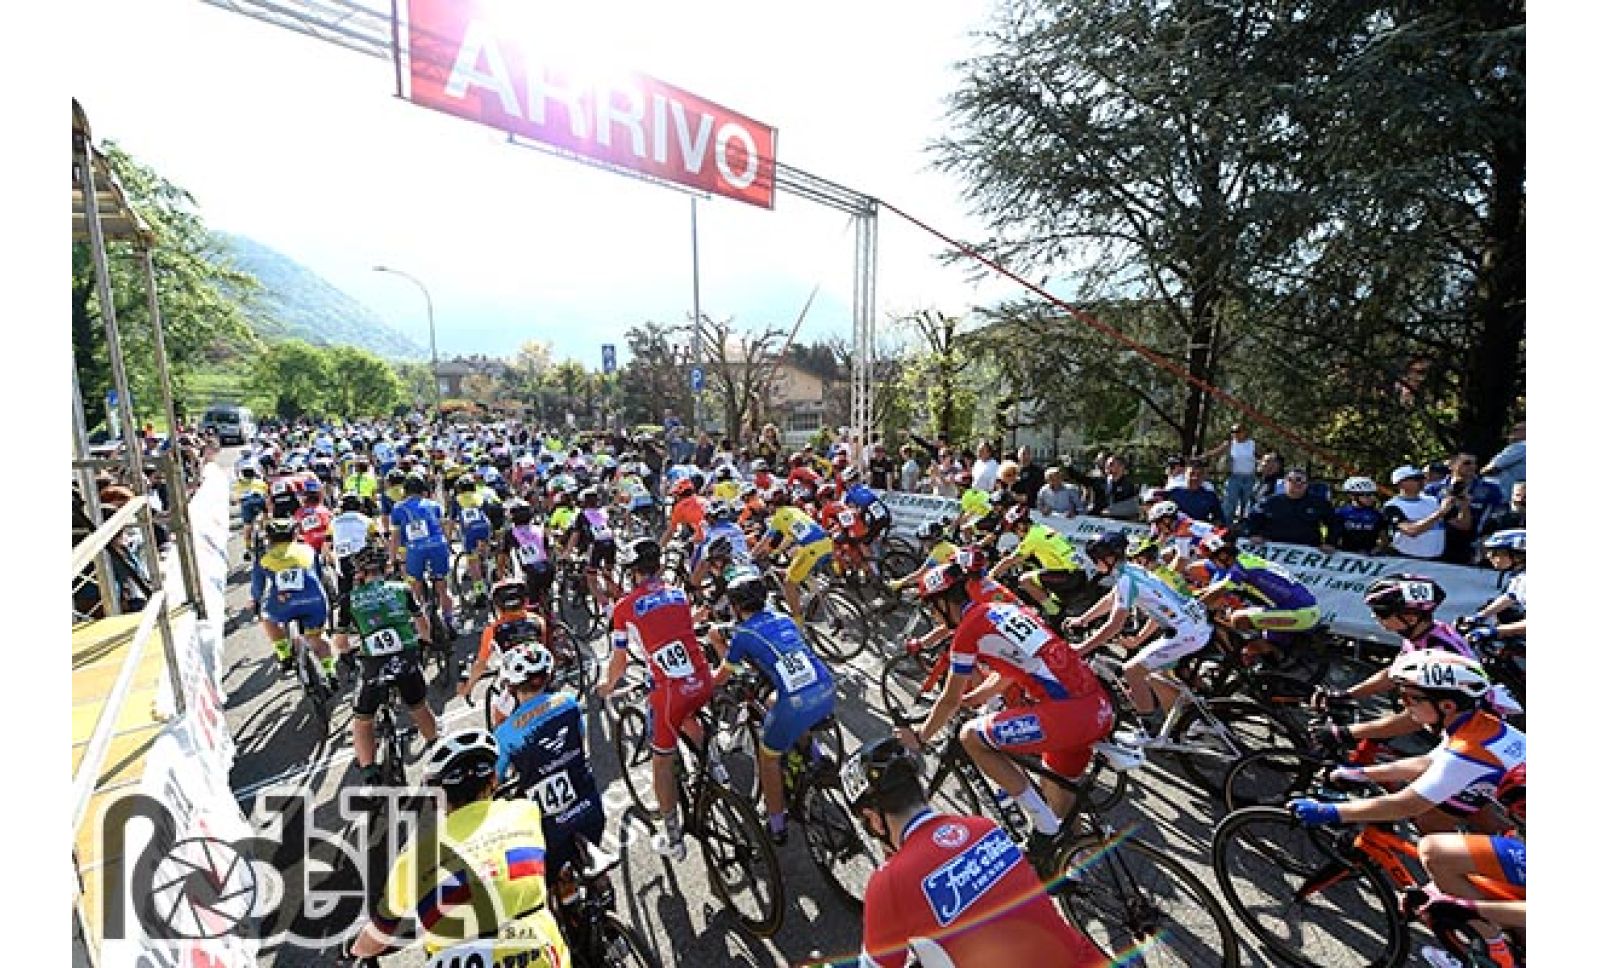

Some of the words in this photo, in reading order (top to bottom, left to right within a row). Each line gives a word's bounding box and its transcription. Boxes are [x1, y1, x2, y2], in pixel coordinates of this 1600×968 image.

[1325, 577, 1367, 594] lavo
[374, 631, 395, 650] 49
[656, 643, 687, 672] 149
[1423, 663, 1455, 687] 104
